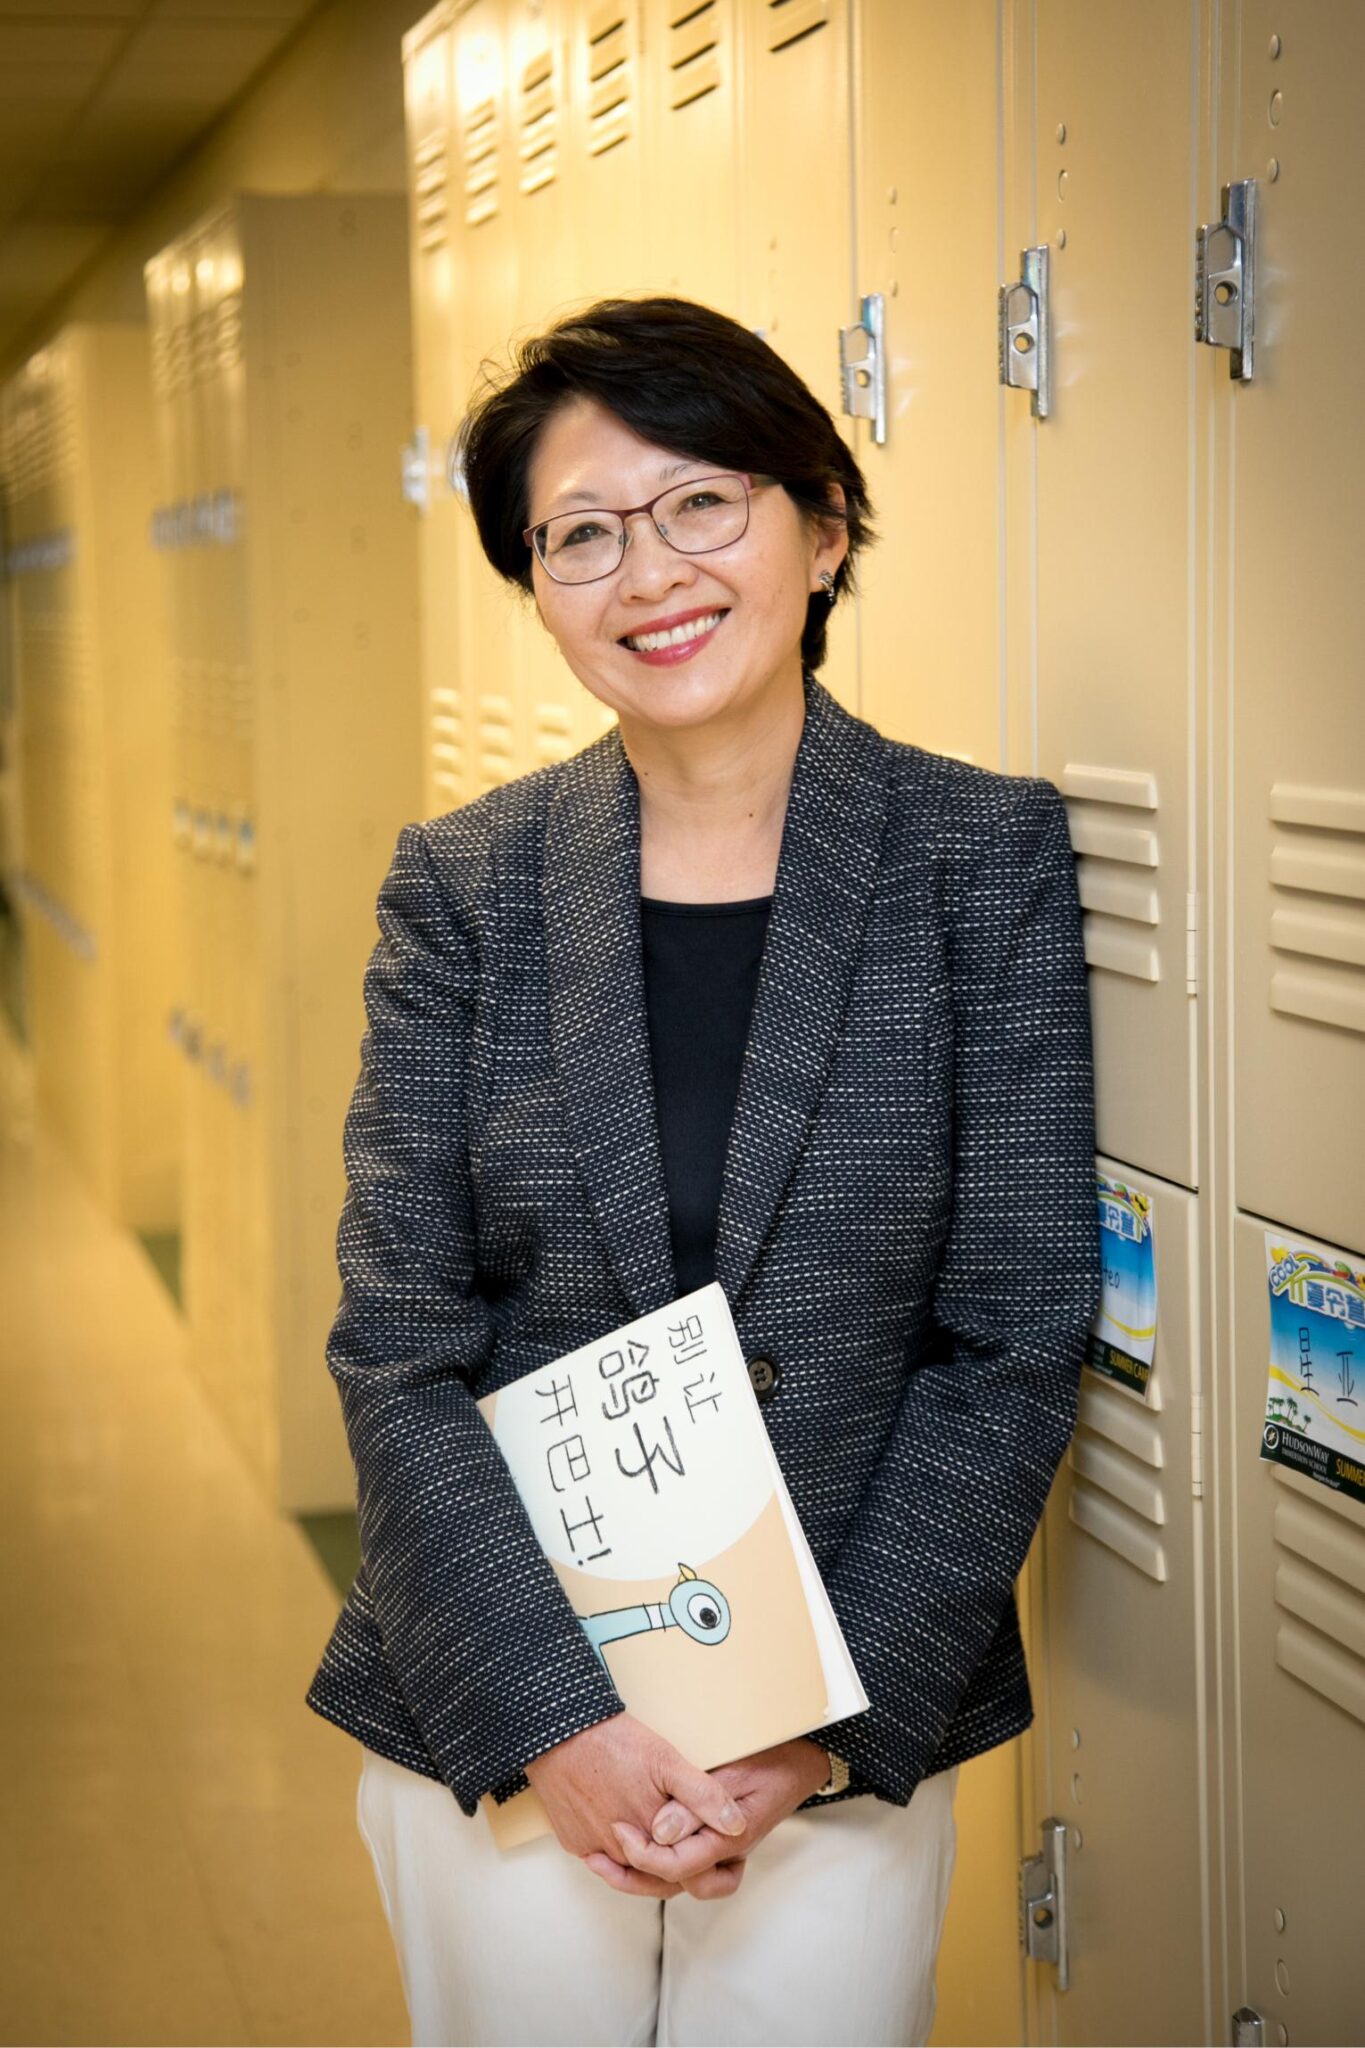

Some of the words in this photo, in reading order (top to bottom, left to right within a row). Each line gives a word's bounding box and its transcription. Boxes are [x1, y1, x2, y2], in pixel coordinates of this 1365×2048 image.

[1101, 1257, 1121, 1288] teo
[1270, 1255, 1300, 1287] COOL
[667, 1314, 723, 1424] 别让
[599, 1339, 686, 1495] 鸽子
[1335, 1457, 1365, 1489] SUMME
